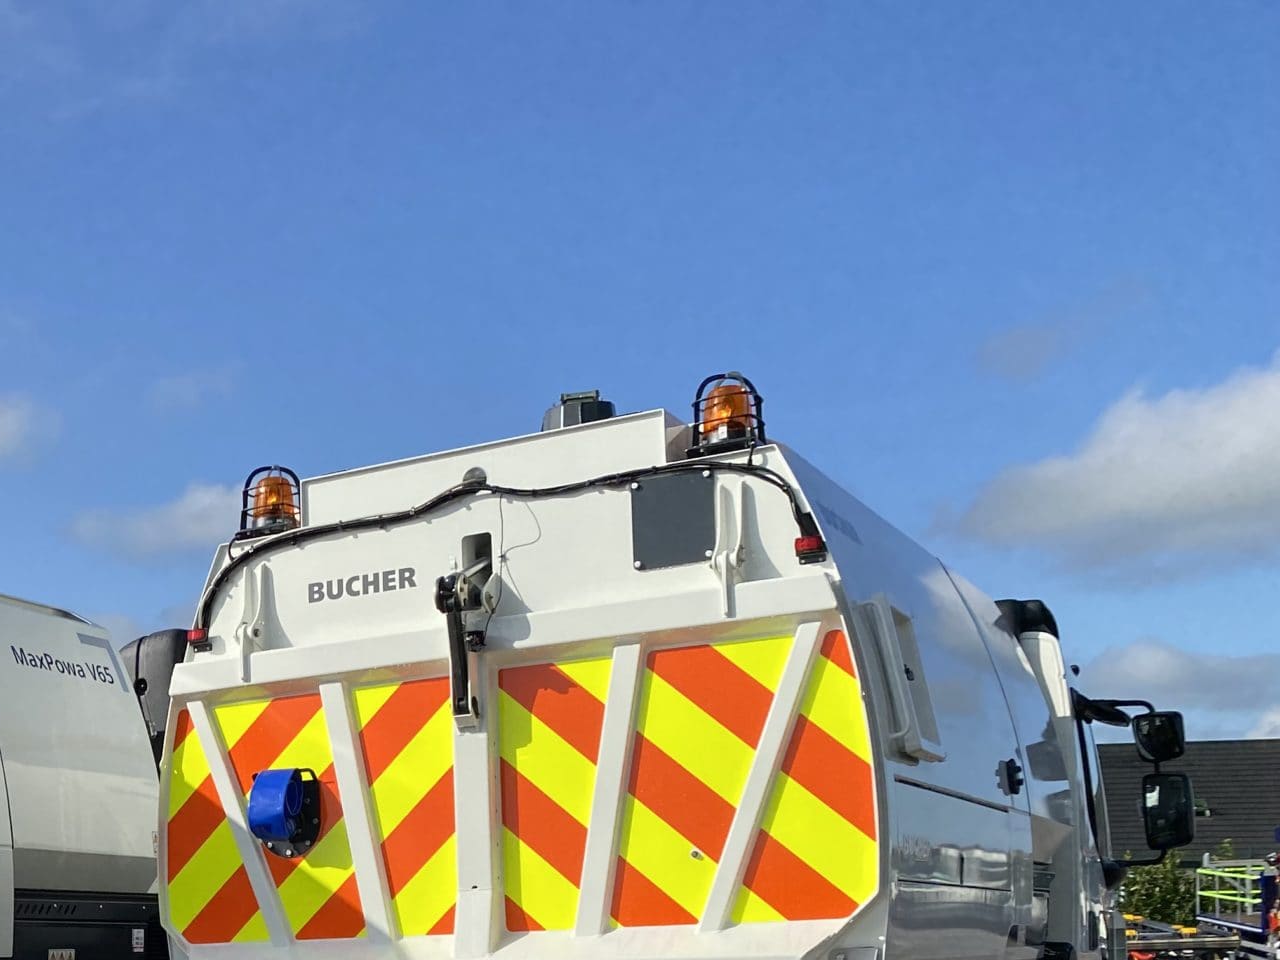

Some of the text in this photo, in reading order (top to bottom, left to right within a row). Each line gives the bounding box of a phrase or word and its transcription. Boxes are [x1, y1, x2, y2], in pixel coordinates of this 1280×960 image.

[308, 567, 417, 604] BUCHER
[10, 645, 115, 685] MaxPowa V65
